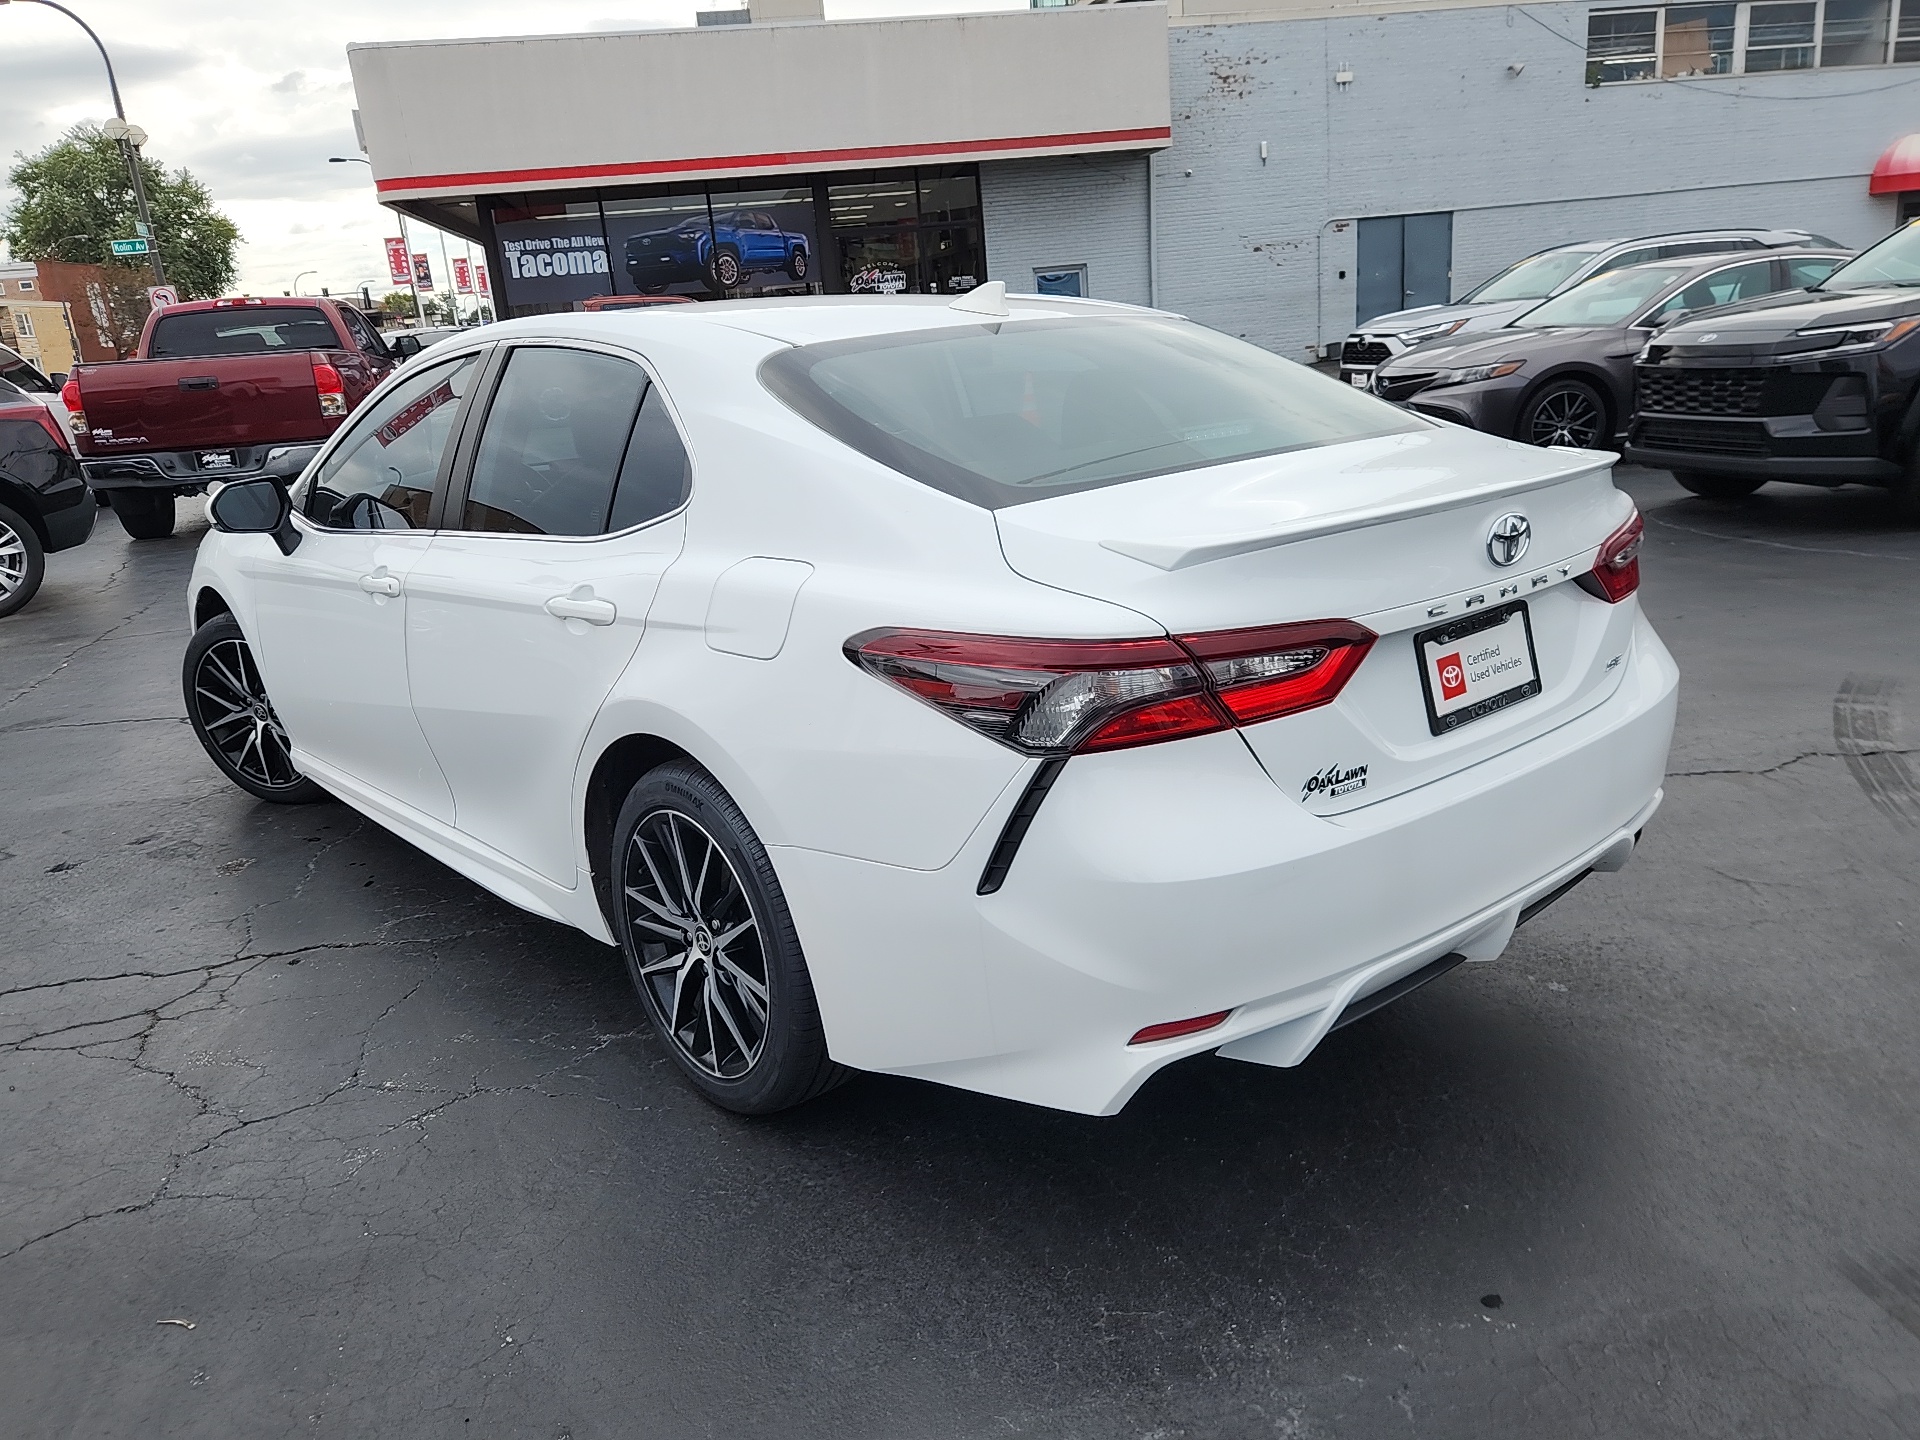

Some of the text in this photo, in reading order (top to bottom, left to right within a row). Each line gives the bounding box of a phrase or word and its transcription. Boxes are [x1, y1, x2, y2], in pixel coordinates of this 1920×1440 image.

[114, 242, 145, 251] Kolin Av
[503, 235, 609, 251] Test Drive The All New
[399, 248, 409, 274] CARS
[505, 250, 612, 278] Tacoma
[860, 261, 899, 271] WELCOME
[1427, 563, 1572, 618] CAMRY
[1466, 644, 1501, 666] Certified
[1470, 656, 1523, 683] Used Vehicles
[1468, 693, 1509, 718] TOYOTA
[1334, 780, 1363, 795] TOYOTA
